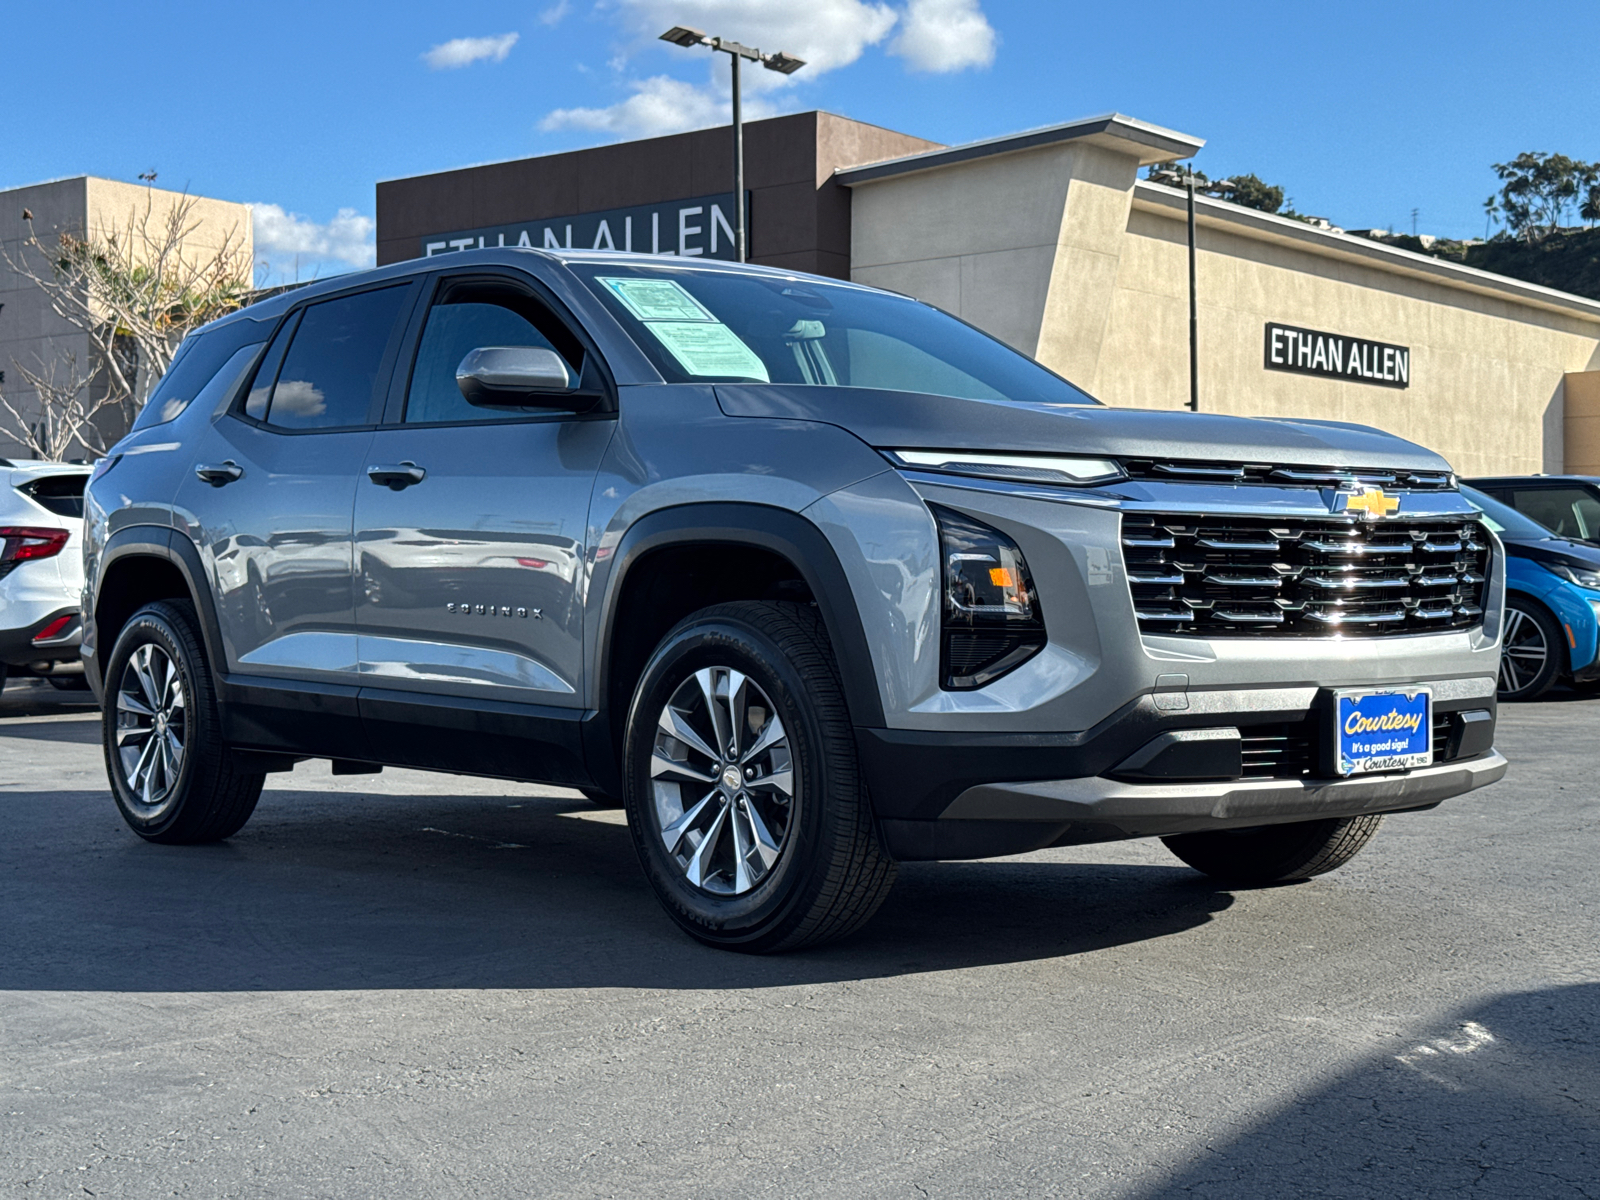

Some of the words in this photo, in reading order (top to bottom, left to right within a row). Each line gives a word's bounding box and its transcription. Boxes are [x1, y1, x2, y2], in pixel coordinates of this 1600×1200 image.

[1271, 327, 1343, 374] ETHAN
[1347, 341, 1408, 383] ALLEN
[447, 602, 543, 620] EQUINOX
[1345, 707, 1423, 735] Courtesy
[1352, 742, 1363, 753] It's
[1364, 744, 1371, 753] a
[1371, 738, 1391, 755] good
[1391, 738, 1409, 753] sign!
[1364, 756, 1408, 771] Courtesy
